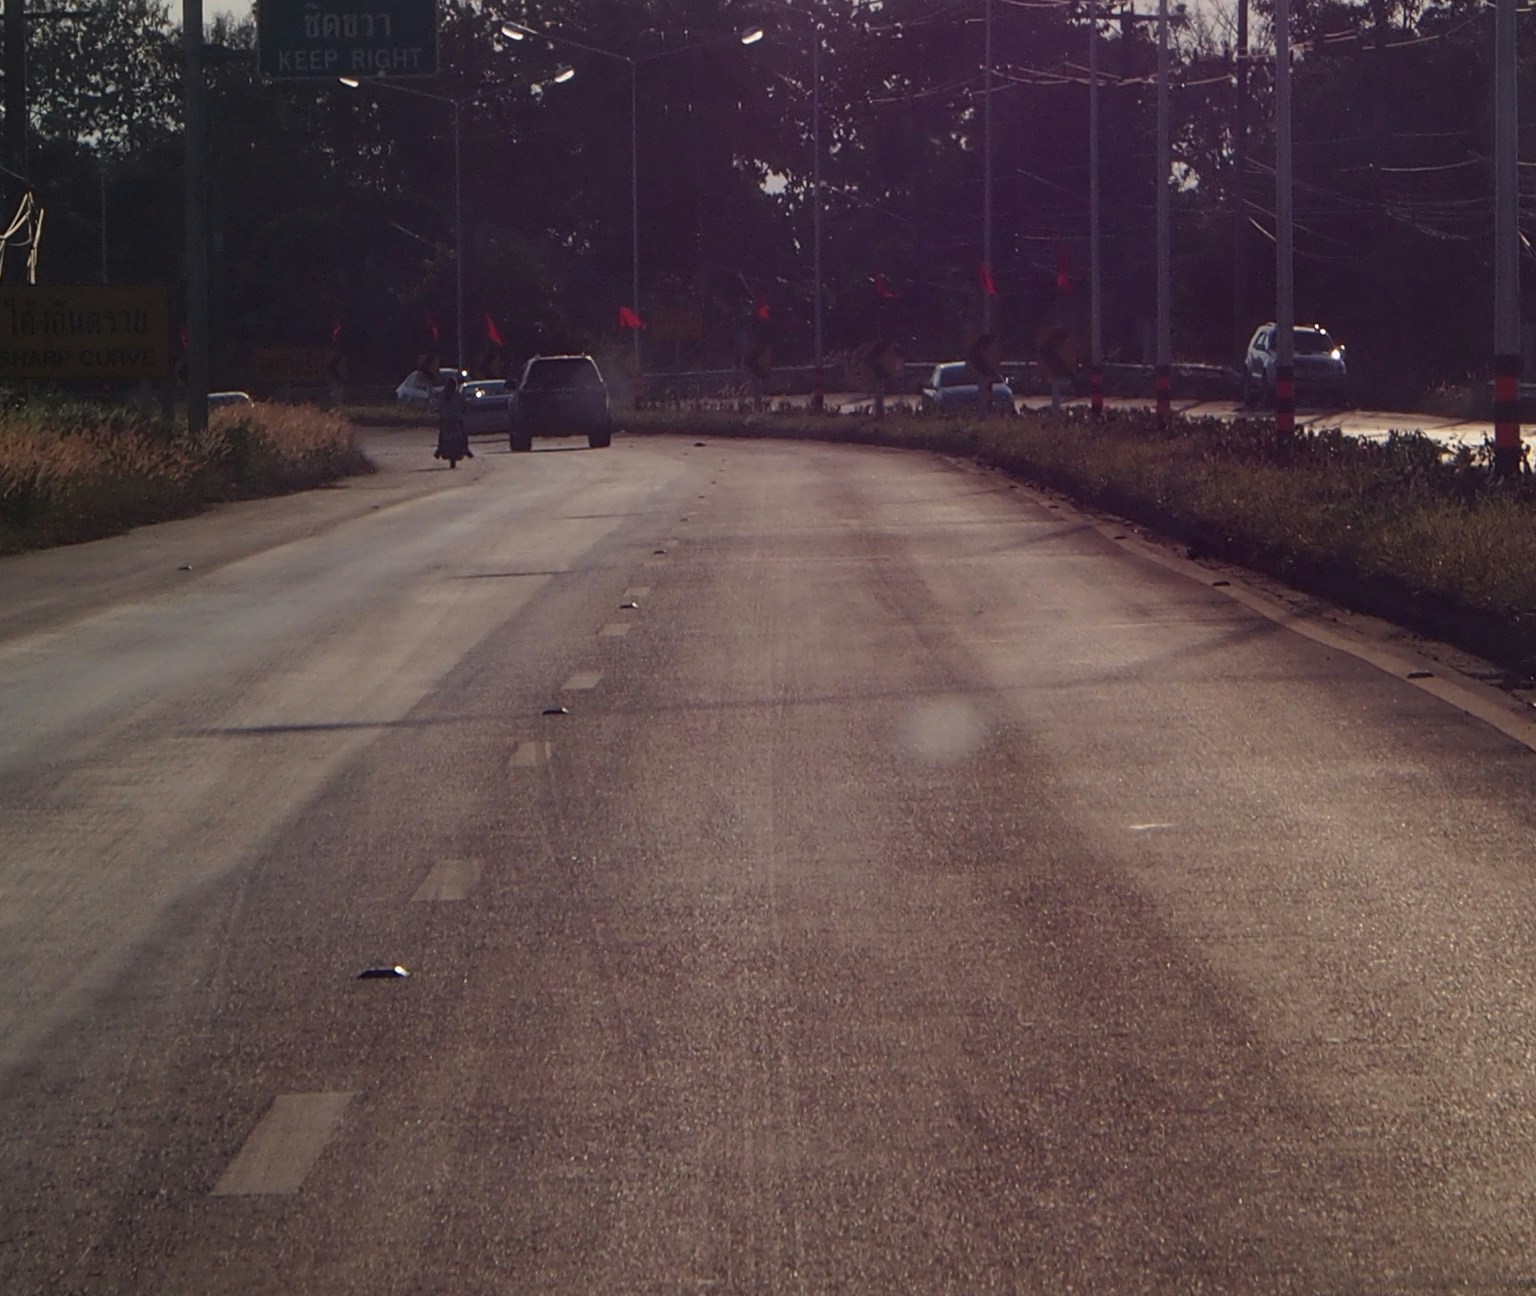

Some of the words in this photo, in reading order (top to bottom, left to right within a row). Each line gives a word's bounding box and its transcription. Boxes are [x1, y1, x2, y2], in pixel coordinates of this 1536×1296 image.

[304, 3, 392, 37] ชิดขวา
[278, 49, 338, 70] KEEP
[352, 47, 423, 69] RIGHT
[79, 348, 156, 368] CURVE
